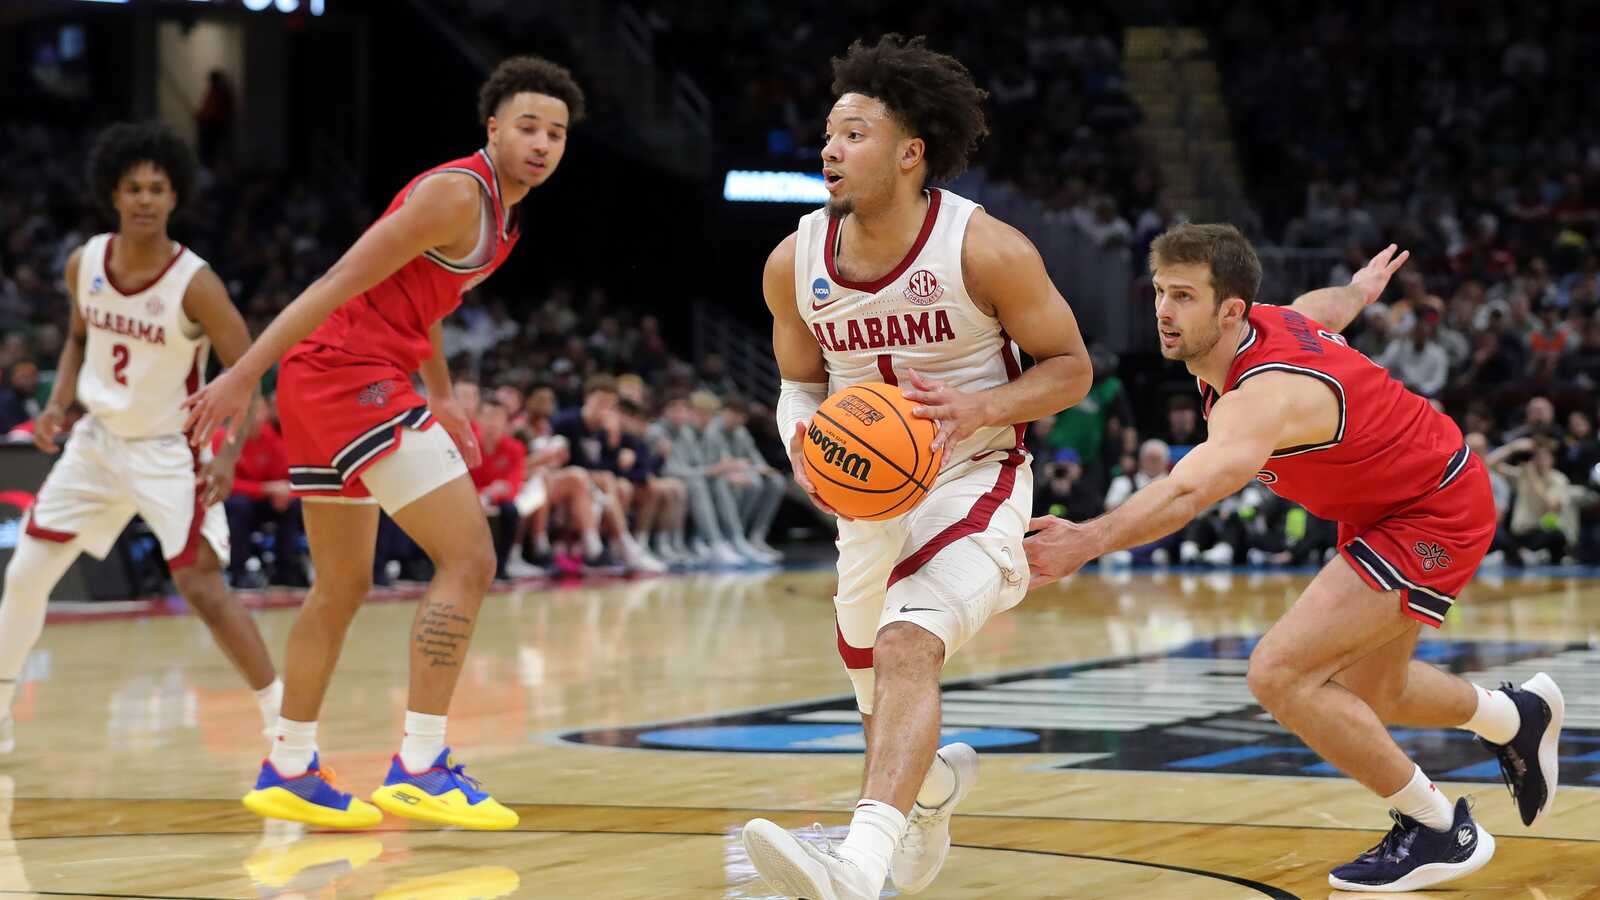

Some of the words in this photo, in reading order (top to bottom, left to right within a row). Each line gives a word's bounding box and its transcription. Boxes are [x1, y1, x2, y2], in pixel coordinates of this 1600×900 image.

[910, 271, 937, 297] SEC
[812, 309, 956, 352] ALABAMA
[112, 344, 130, 386] 2
[808, 419, 872, 483] Wilson
